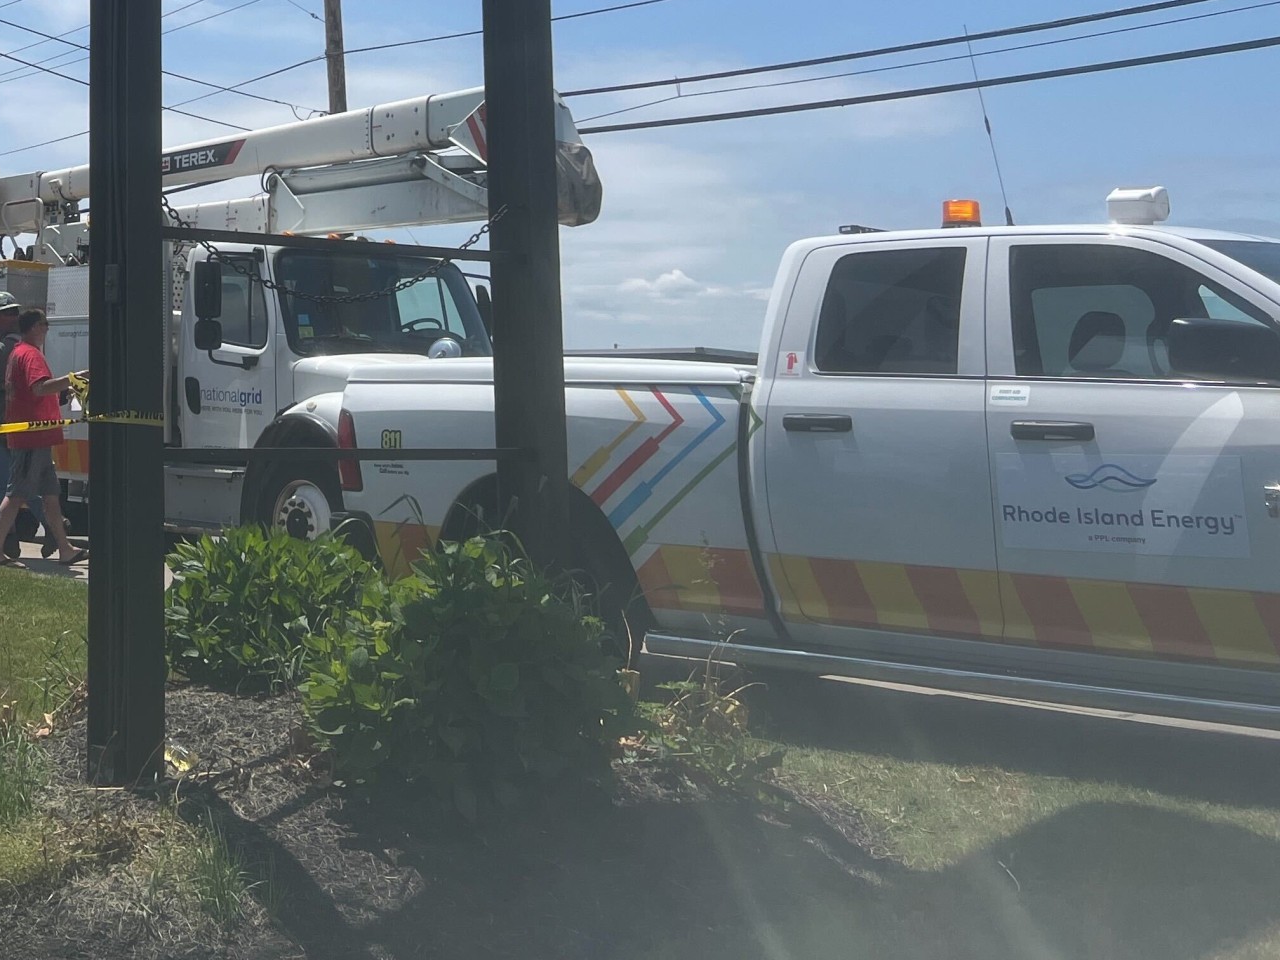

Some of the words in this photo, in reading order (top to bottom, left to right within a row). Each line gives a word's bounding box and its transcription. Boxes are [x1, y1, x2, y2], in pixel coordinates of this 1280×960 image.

[173, 149, 216, 169] TEREX
[381, 429, 401, 448] 811
[1002, 505, 1070, 524] Rhode
[1077, 507, 1144, 527] Island
[1151, 509, 1236, 535] Energy
[1094, 534, 1110, 542] PPL
[1111, 536, 1146, 544] company
